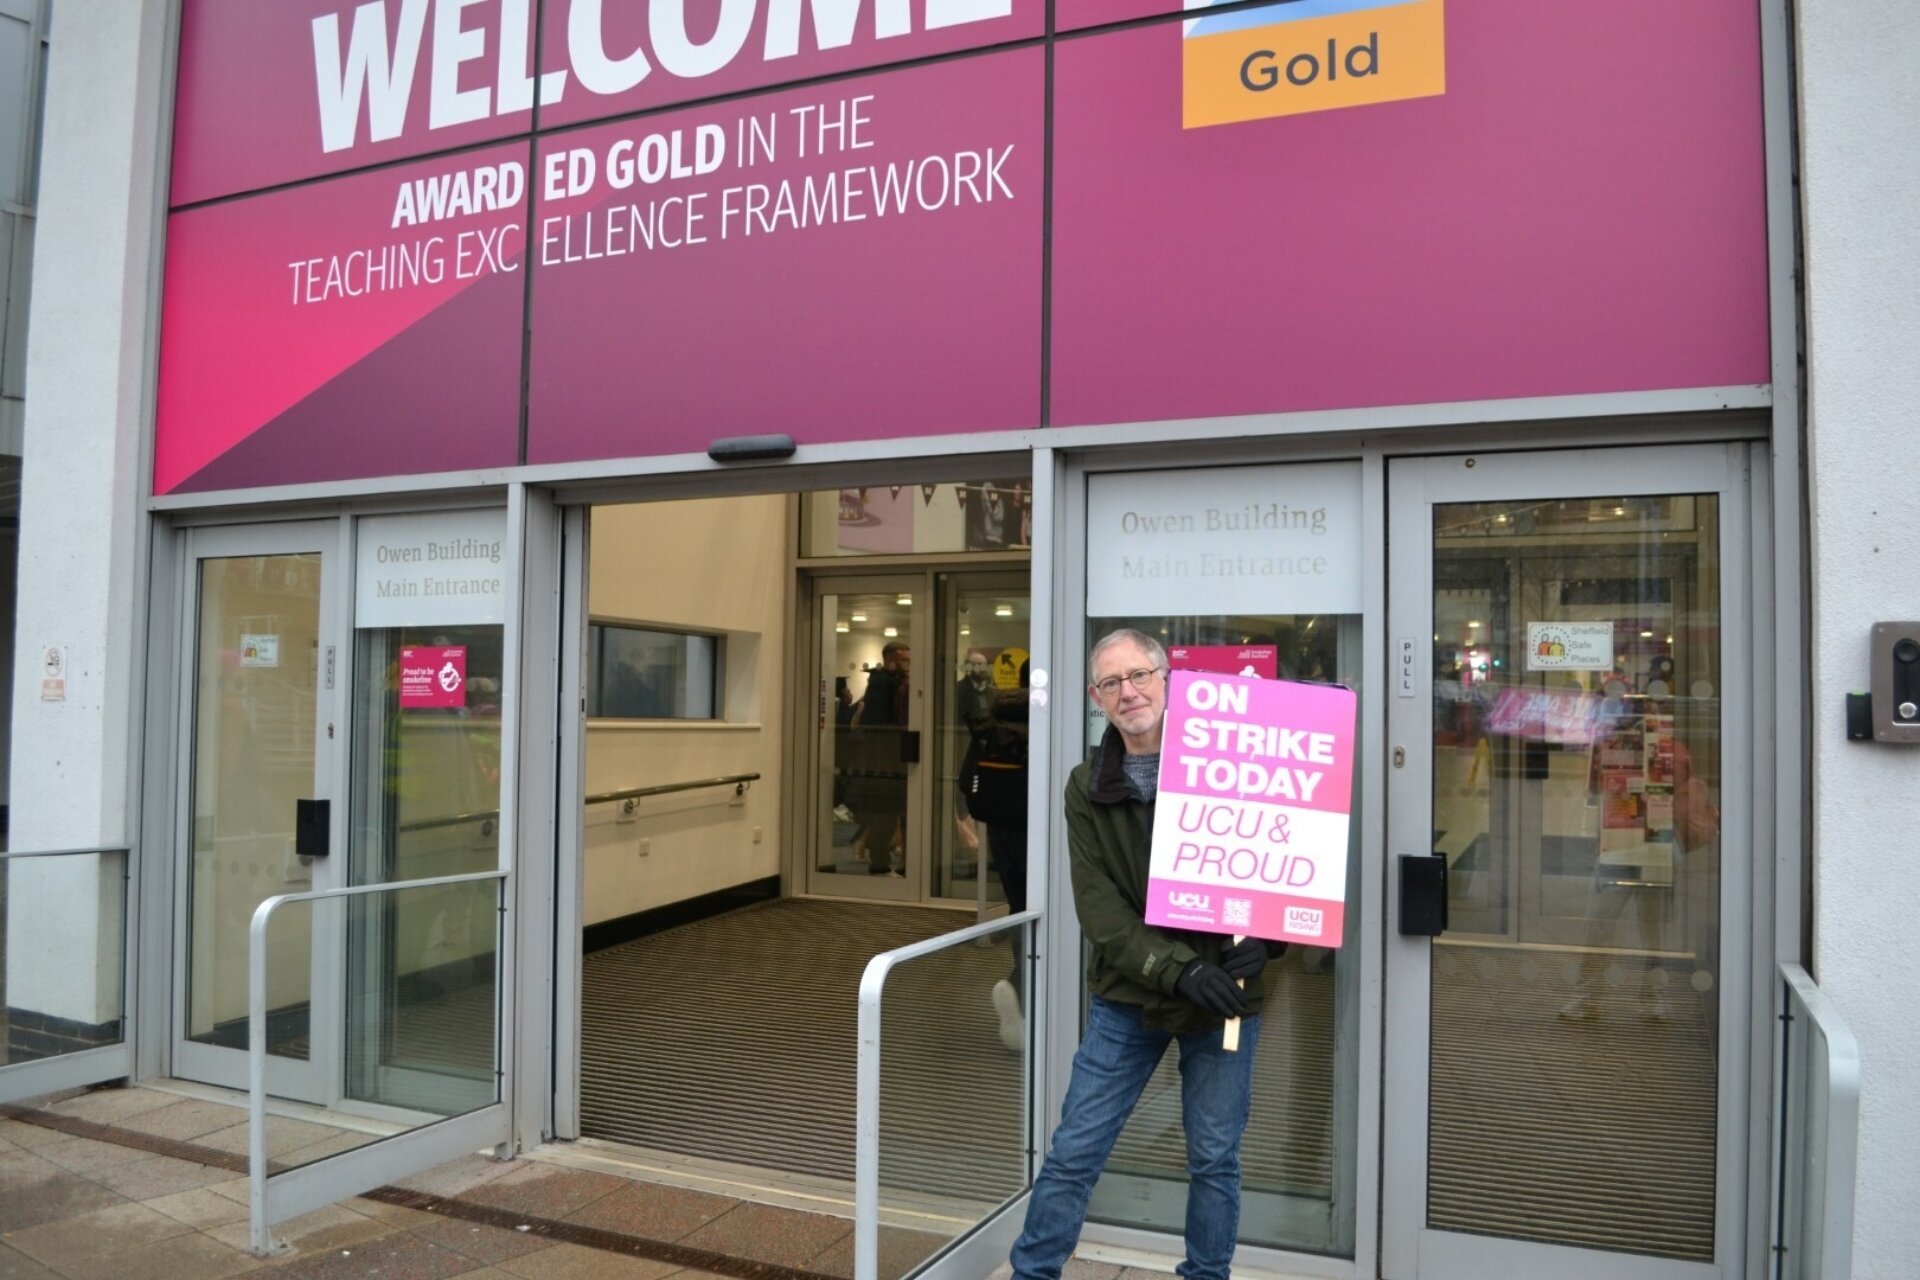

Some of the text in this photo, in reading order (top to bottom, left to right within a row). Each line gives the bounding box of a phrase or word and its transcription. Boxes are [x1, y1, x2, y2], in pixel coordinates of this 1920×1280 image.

[1240, 31, 1378, 92] Gold
[606, 123, 726, 189] GOLD
[737, 112, 775, 168] IN
[790, 94, 875, 158] THE
[288, 236, 444, 305] TEACHING
[721, 144, 1014, 239] FRAMEWORK
[1121, 503, 1327, 536] Owen Building
[377, 539, 501, 564] Owen Building
[1121, 552, 1327, 579] Main Entrance
[377, 577, 501, 598] Main Entrance
[1571, 626, 1609, 635] Sheffield
[1571, 640, 1592, 649] Safe
[1571, 655, 1600, 663] Places
[1186, 679, 1249, 715] ON
[1182, 717, 1335, 765] STRIKE
[1179, 755, 1324, 802] TODAY
[1178, 801, 1291, 844] UCU &
[1172, 842, 1316, 887] PROUD
[1288, 921, 1320, 933] RISING
[1289, 910, 1320, 923] UCU
